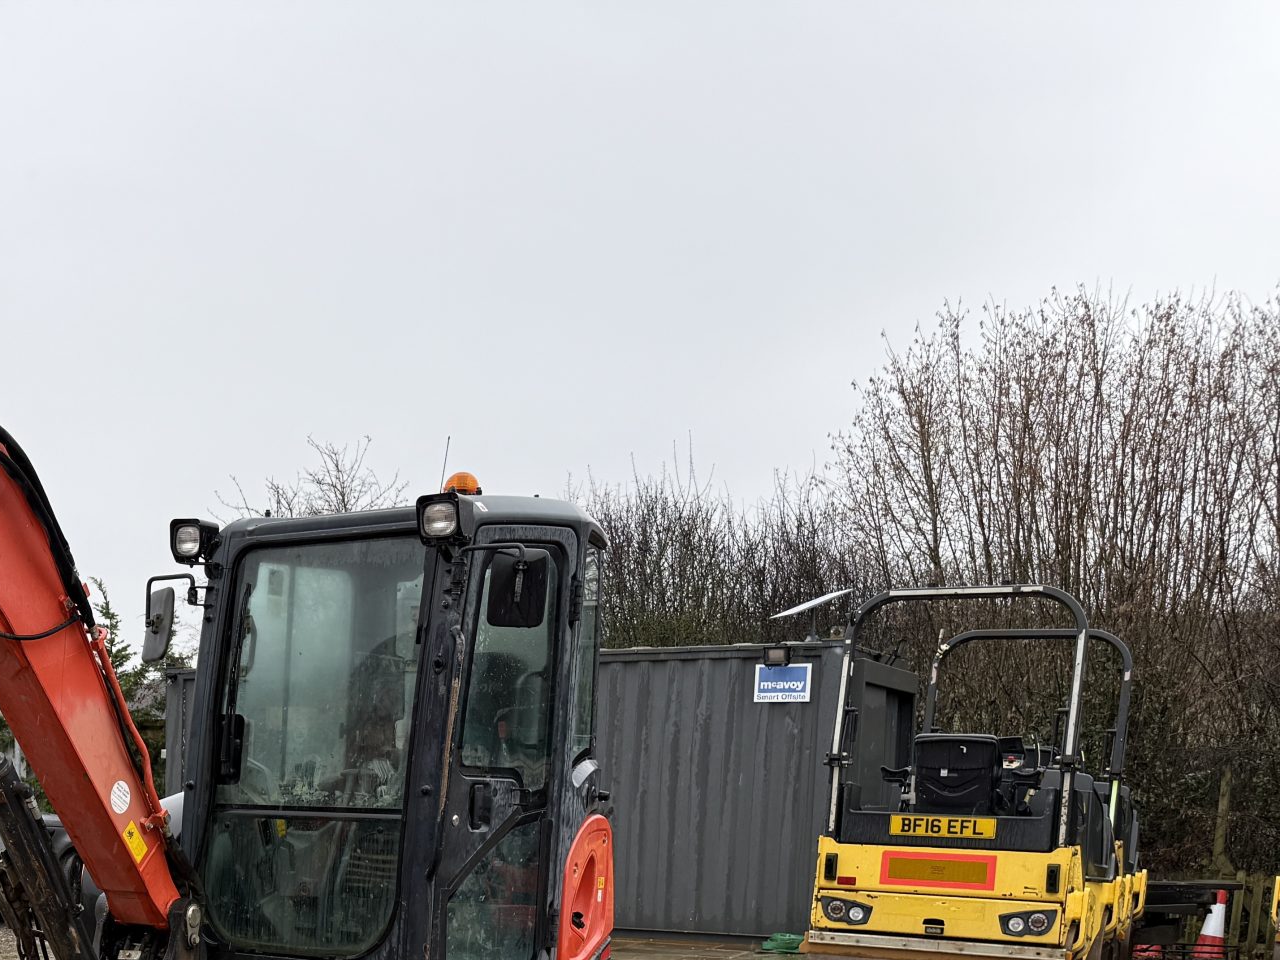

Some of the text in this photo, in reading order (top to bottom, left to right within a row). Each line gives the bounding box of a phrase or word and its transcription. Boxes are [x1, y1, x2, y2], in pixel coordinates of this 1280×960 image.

[760, 681, 804, 691] mcavoy
[756, 693, 806, 701] Smart Offsite
[900, 817, 984, 836] BF16 EFL
